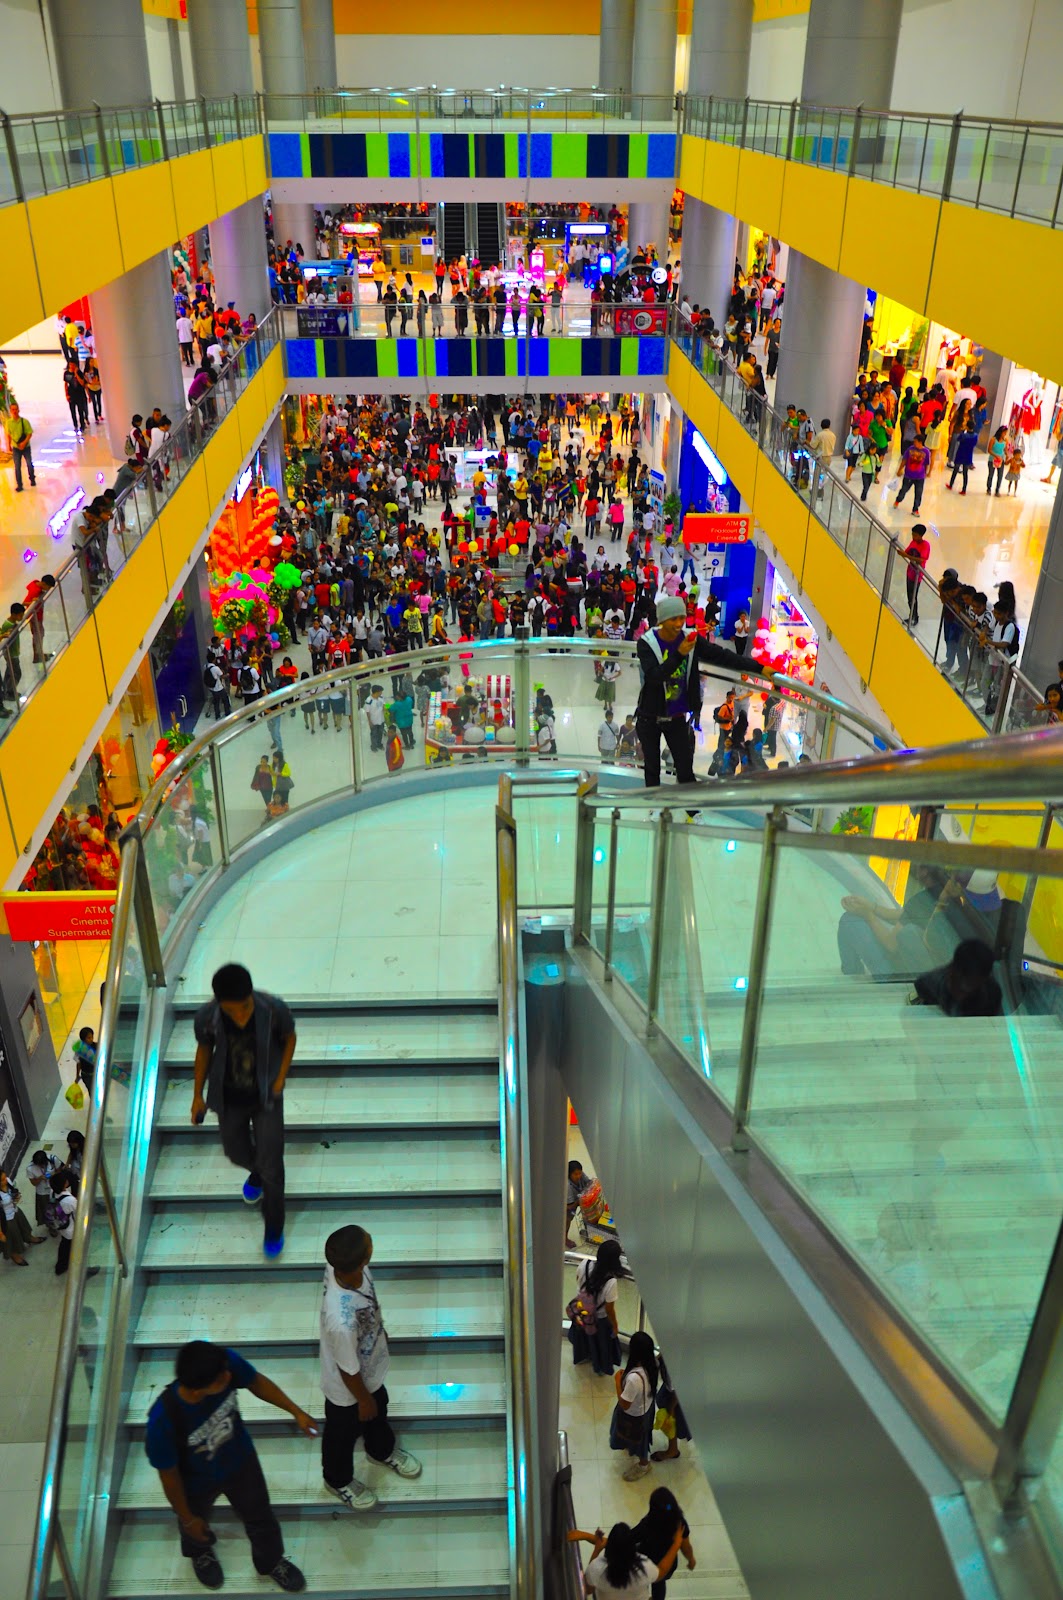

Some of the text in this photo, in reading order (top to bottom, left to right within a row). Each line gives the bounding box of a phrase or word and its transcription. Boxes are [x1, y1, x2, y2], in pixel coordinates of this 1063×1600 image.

[84, 906, 107, 914] ATM
[70, 918, 109, 926] Cinema
[48, 928, 111, 938] Supermarket
